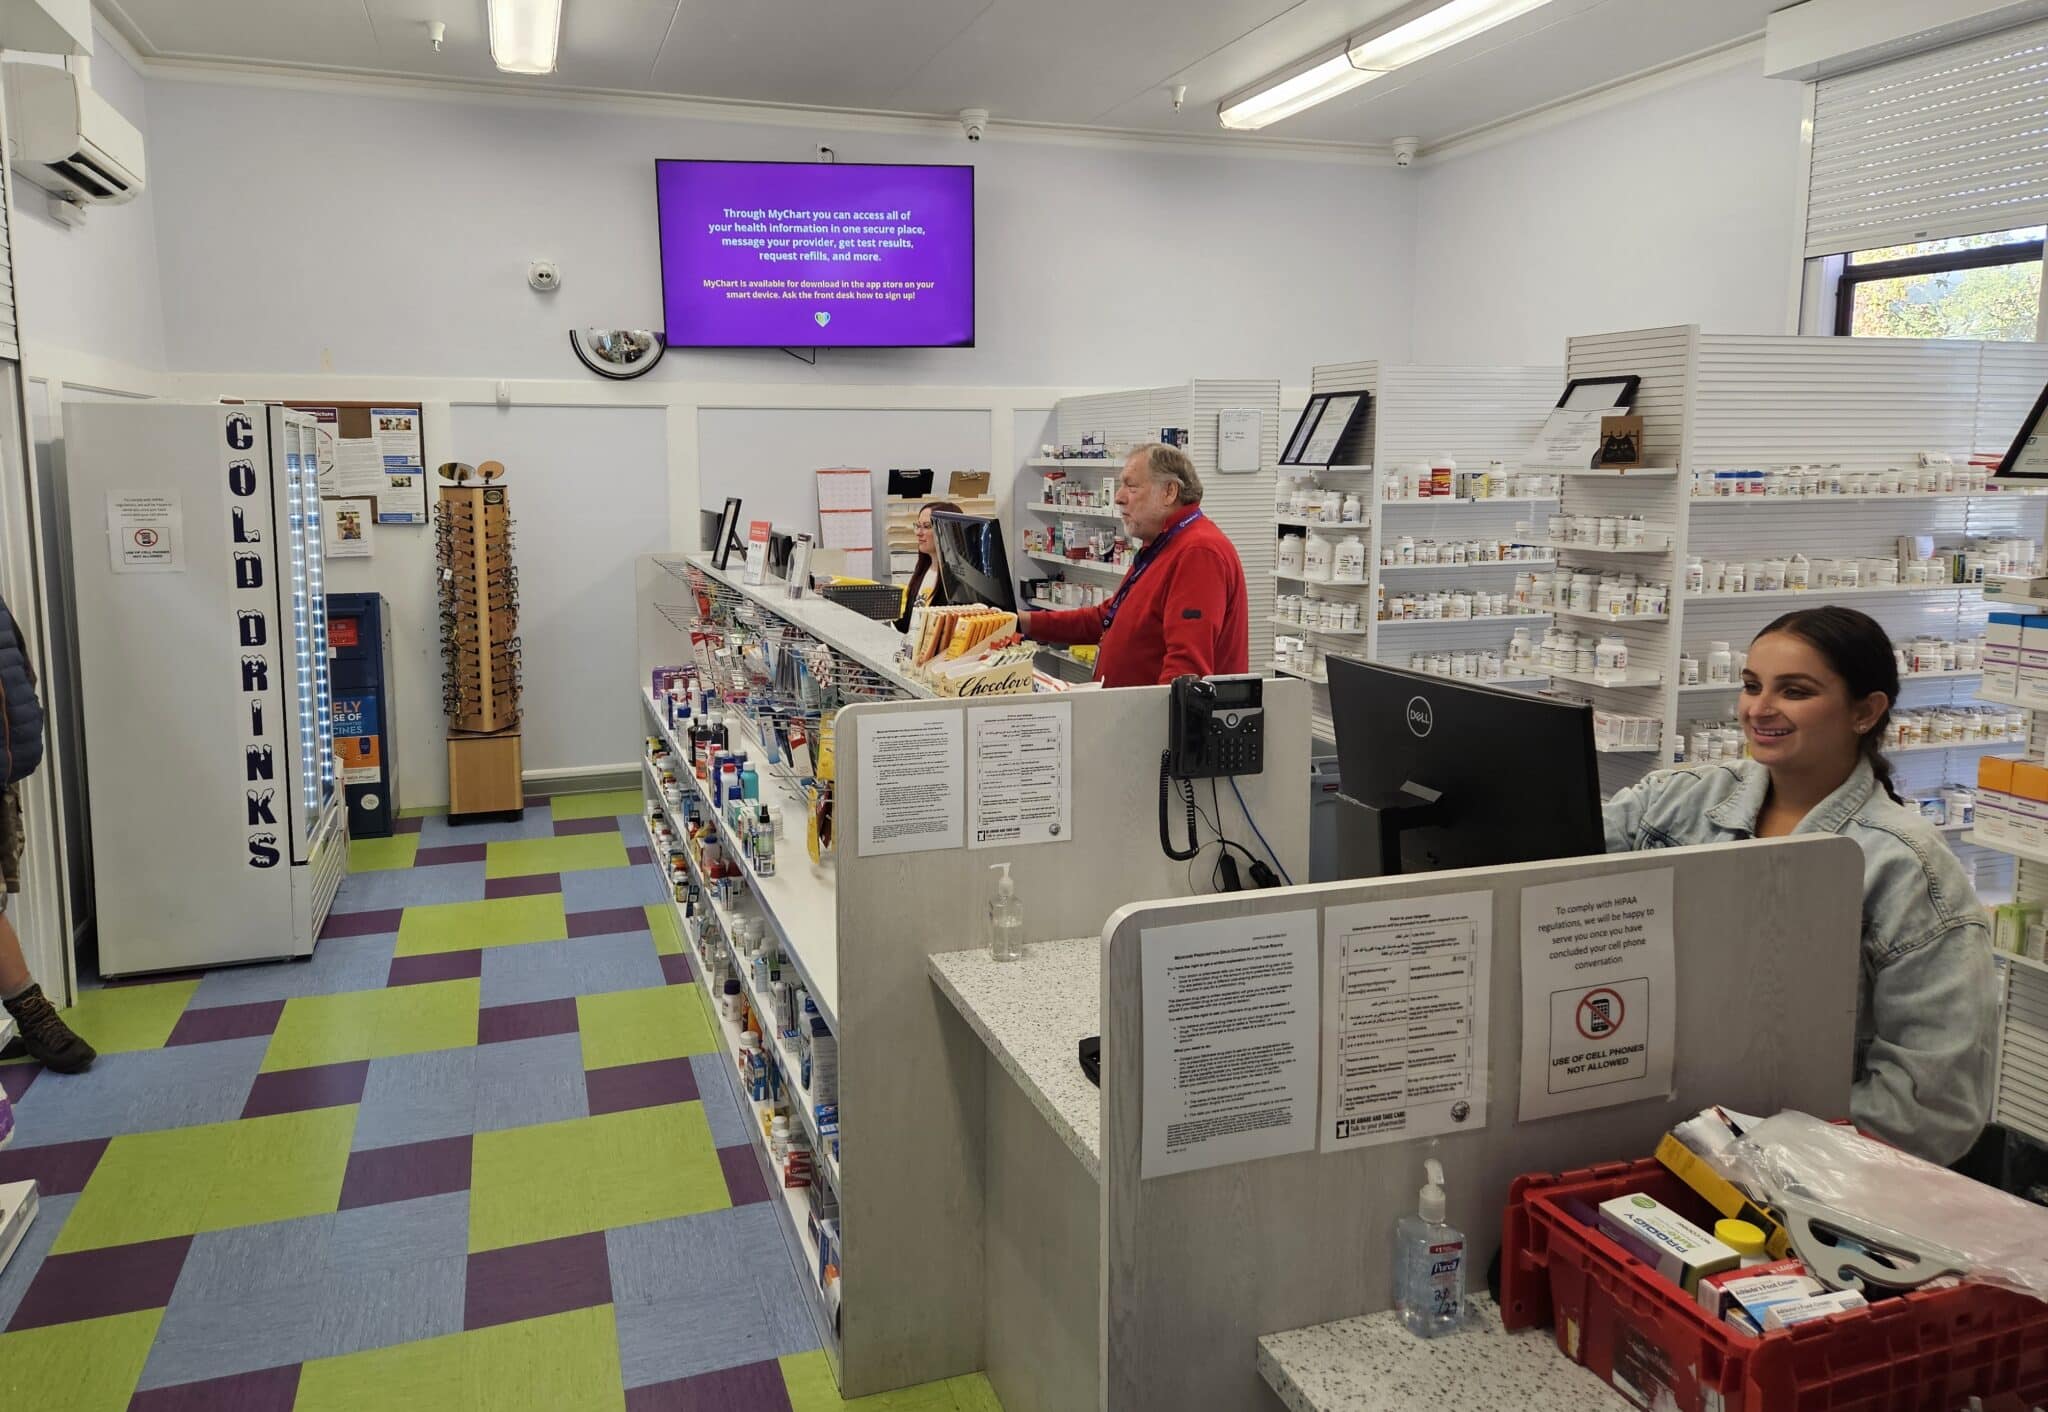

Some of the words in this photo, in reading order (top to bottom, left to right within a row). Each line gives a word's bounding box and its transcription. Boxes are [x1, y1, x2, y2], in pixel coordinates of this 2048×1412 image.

[723, 208, 766, 221] Through
[768, 209, 810, 222] MyChart
[812, 211, 832, 222] you
[833, 211, 851, 221] can
[853, 212, 884, 221] access
[886, 210, 898, 221] all
[900, 210, 911, 221] of
[708, 224, 732, 235] your
[734, 222, 767, 233] health
[769, 223, 829, 234] information
[831, 223, 841, 234] in
[842, 225, 861, 234] one
[863, 226, 895, 234] secure
[897, 224, 925, 236] place,
[721, 238, 765, 248] message
[767, 238, 790, 248] your
[792, 236, 836, 249] provider,
[839, 238, 855, 250] get
[857, 238, 876, 248] test
[878, 237, 914, 250] results,
[759, 251, 798, 263] request
[799, 250, 830, 262] refills,
[832, 251, 851, 261] and
[853, 252, 881, 262] more.
[703, 279, 738, 289] MyChart
[749, 279, 785, 288] available
[787, 279, 799, 288] for
[800, 280, 840, 288] download
[842, 280, 849, 288] in
[851, 280, 864, 288] the
[866, 281, 881, 290] app
[883, 281, 903, 289] store
[904, 281, 915, 289] on
[916, 282, 934, 291] your
[726, 290, 750, 299] smart
[752, 289, 780, 299] device.
[782, 290, 797, 299] Ask
[798, 290, 812, 299] the
[814, 290, 835, 300] front
[836, 290, 855, 300] desk
[856, 290, 872, 300] how
[874, 291, 883, 300] to
[885, 291, 901, 301] sign
[903, 291, 916, 301] up!
[226, 412, 263, 588] COLD
[958, 672, 1031, 697] Chocolove
[333, 702, 361, 713] ELY
[1410, 709, 1430, 724] DELL
[237, 609, 280, 868] DRINKS
[1556, 906, 1565, 915] To
[1567, 902, 1594, 913] comply
[1596, 901, 1612, 909] with
[1614, 896, 1637, 906] HIPAA
[1597, 914, 1610, 923] will
[1612, 913, 1621, 921] be
[1623, 910, 1645, 919] happy
[1646, 908, 1654, 916] to
[1552, 935, 1572, 944] serve
[1574, 933, 1588, 942] you
[1590, 930, 1607, 939] once
[1609, 927, 1623, 937] you
[1624, 925, 1642, 933] have
[1549, 947, 1588, 960] concluded
[1590, 944, 1606, 955] your
[1608, 941, 1621, 950] cell
[1623, 938, 1646, 949] phone
[1552, 1056, 1570, 1066] USE
[1572, 1054, 1584, 1063] OF
[1586, 1051, 1607, 1060] CELL
[1609, 1043, 1644, 1056] PHONES
[1567, 1065, 1585, 1075] NOT
[1587, 1057, 1629, 1071] ALLOWED
[1623, 1213, 1689, 1254] PRODIGY
[1735, 1284, 1762, 1296] Athlete's
[1762, 1281, 1778, 1290] Foot
[1779, 1278, 1799, 1287] Cream
